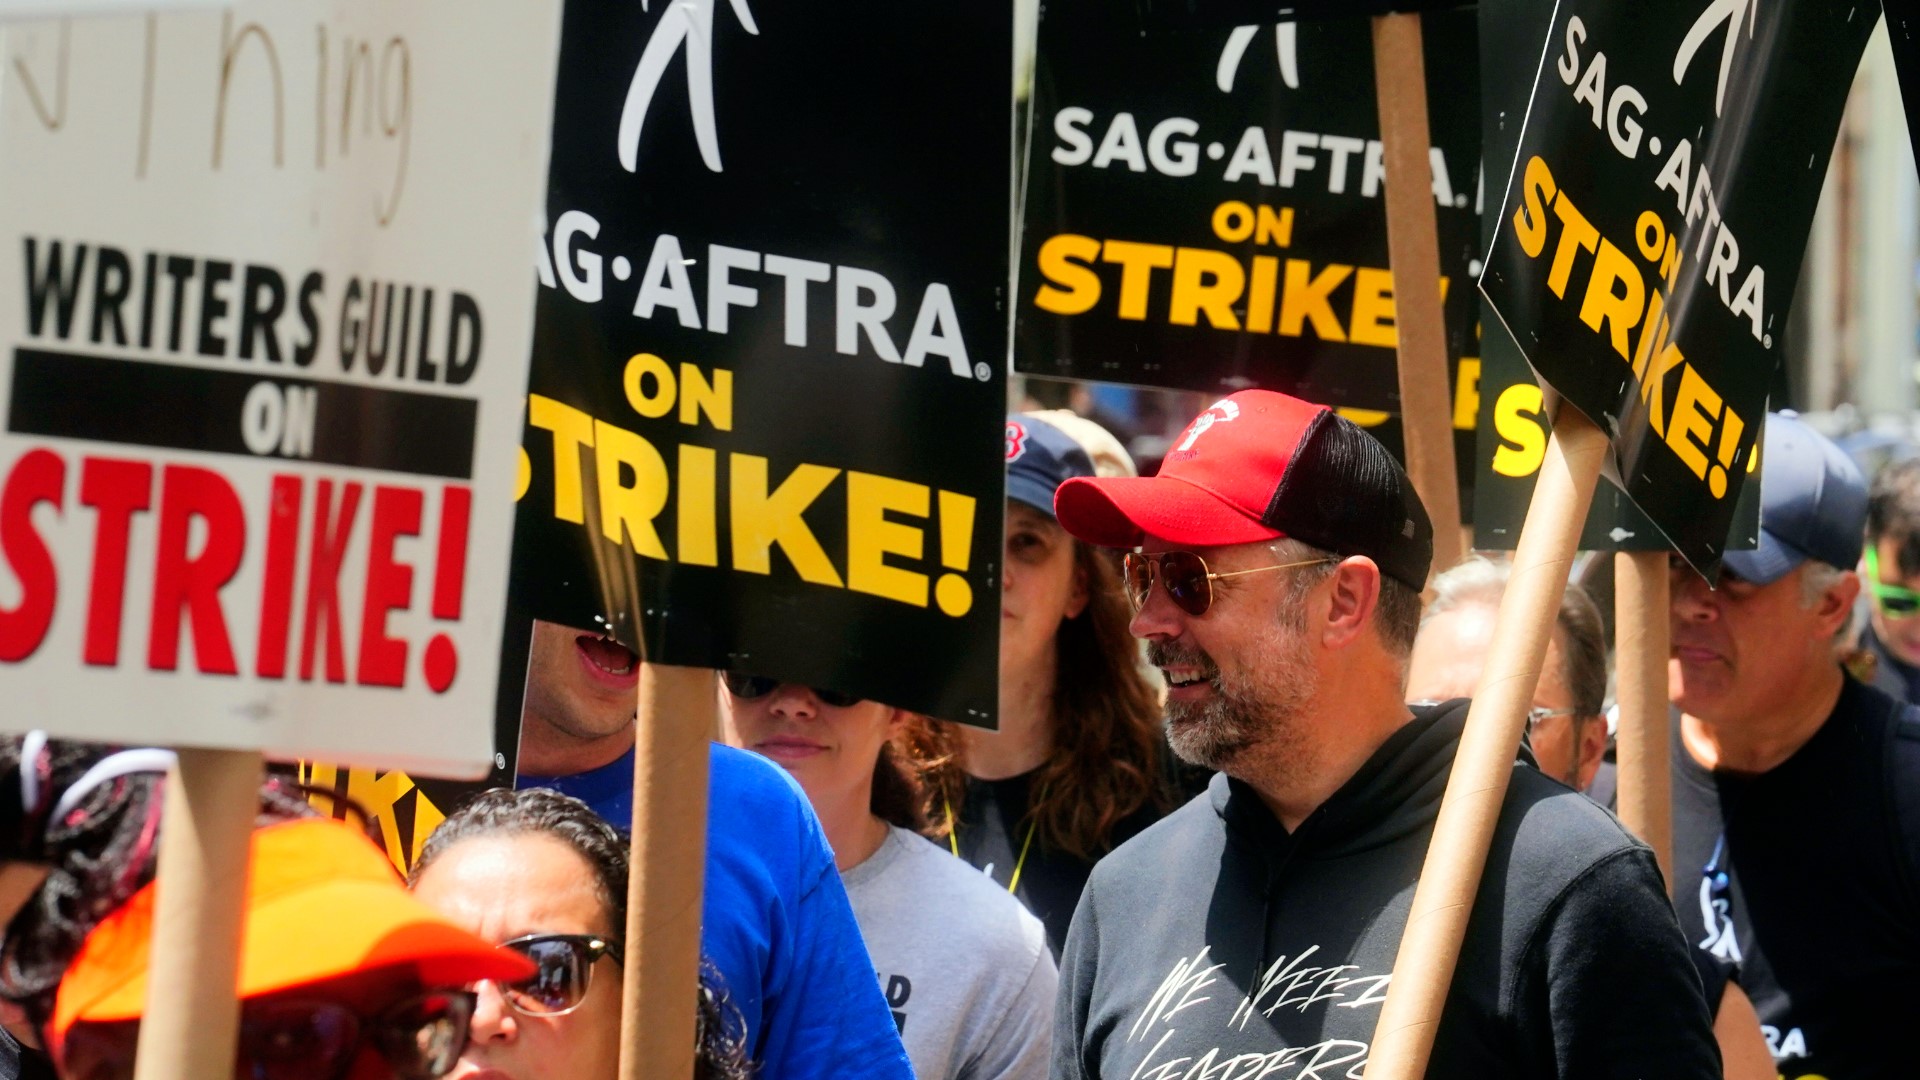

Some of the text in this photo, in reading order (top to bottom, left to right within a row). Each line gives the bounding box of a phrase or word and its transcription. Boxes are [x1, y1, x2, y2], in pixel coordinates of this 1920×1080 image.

[1211, 201, 1294, 248] ON
[1635, 210, 1683, 293] ON
[23, 235, 484, 386] WRITERS GUILD
[1513, 155, 1744, 499] STRIKE!
[241, 382, 317, 456] ON
[623, 353, 733, 431] ON
[513, 393, 976, 617] TRIKE!
[0, 447, 473, 693] STRIKE!
[1127, 945, 1227, 1042] WE
